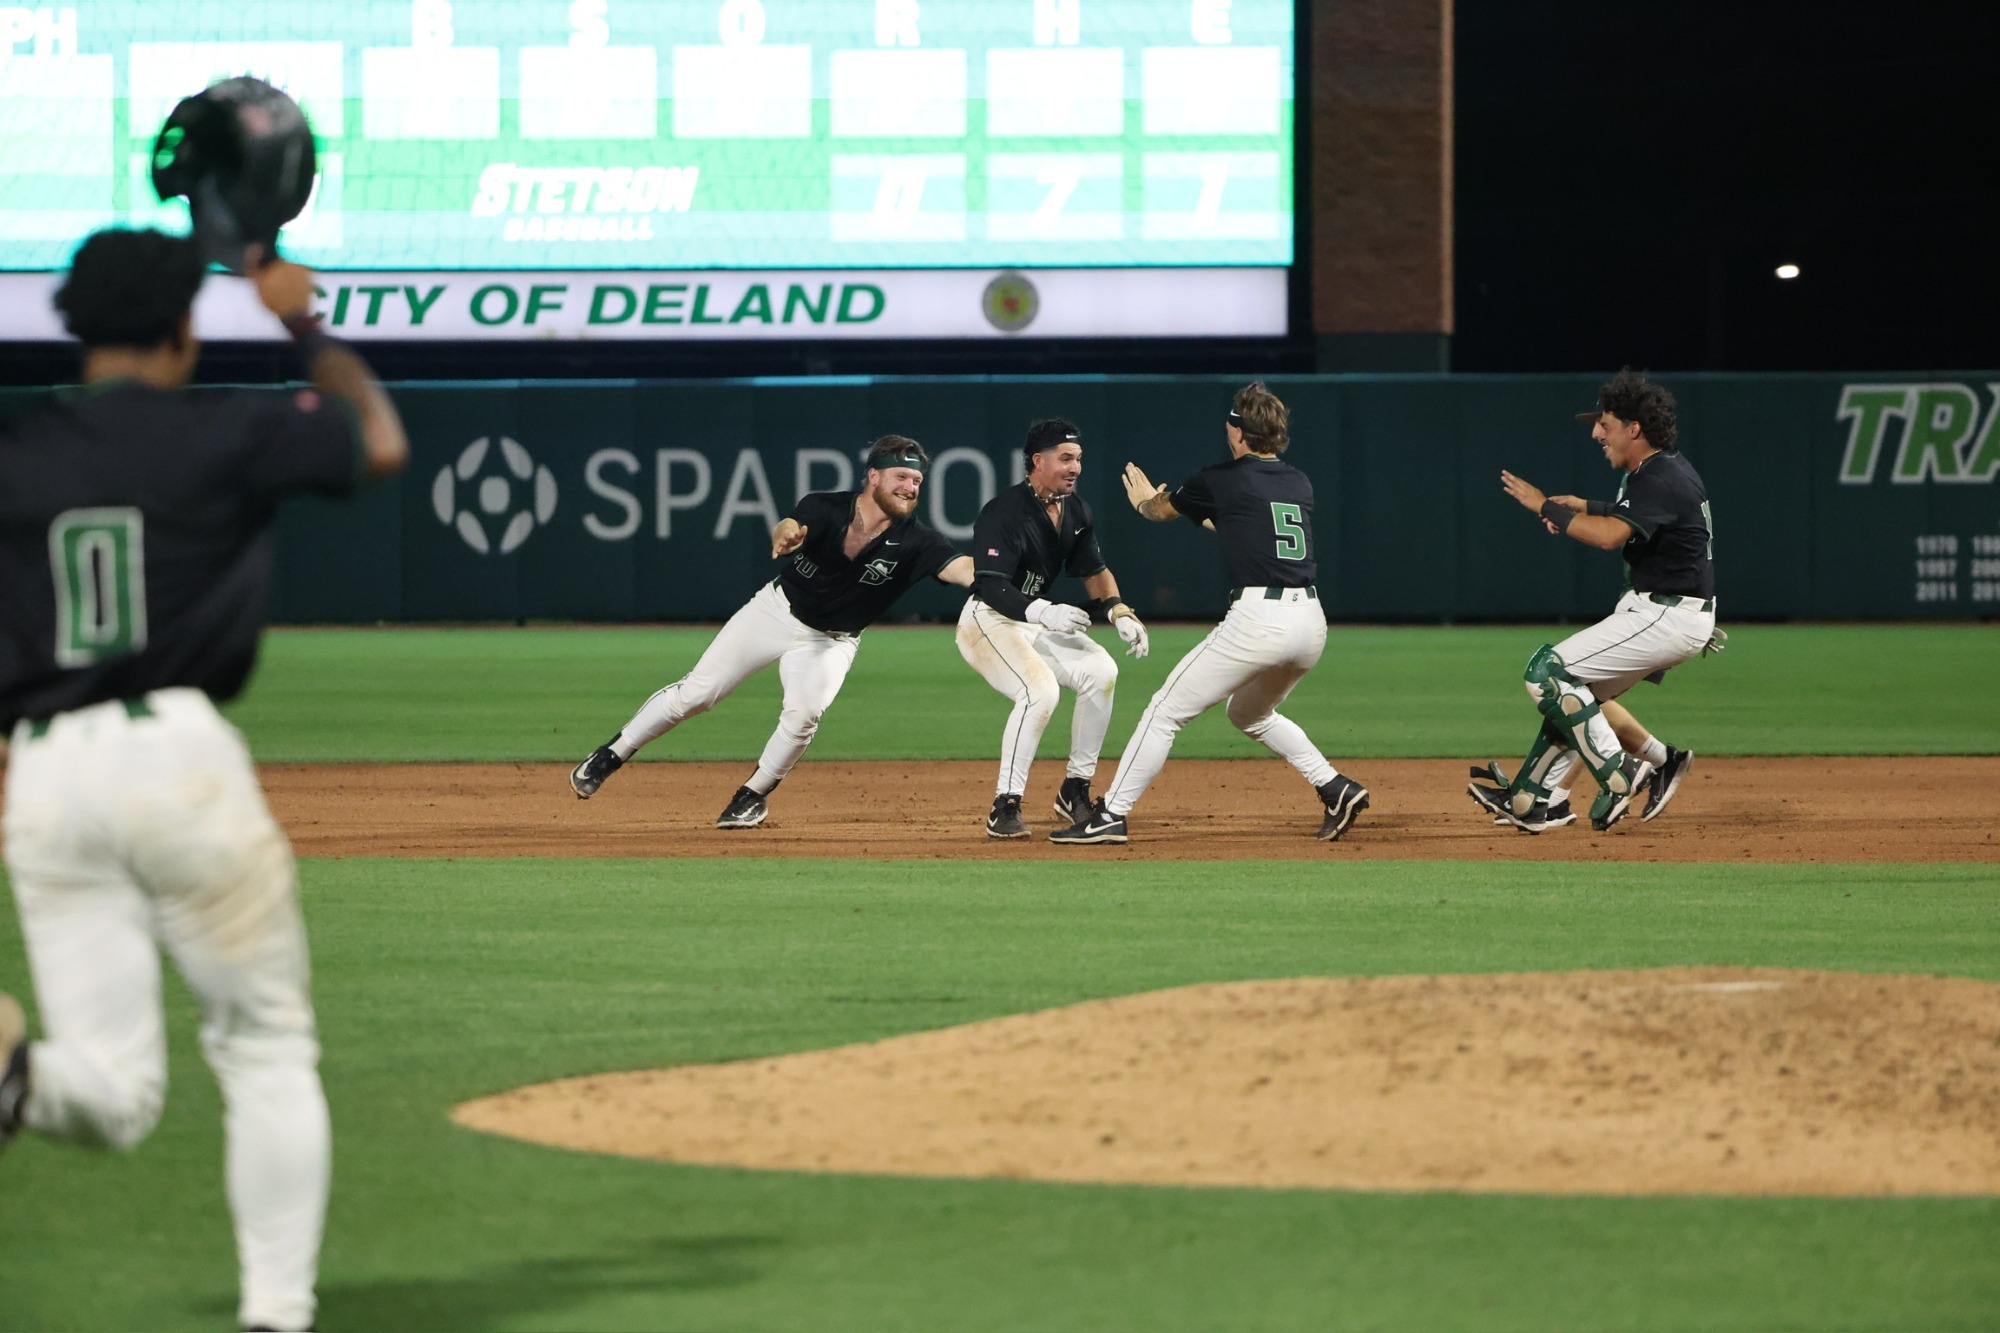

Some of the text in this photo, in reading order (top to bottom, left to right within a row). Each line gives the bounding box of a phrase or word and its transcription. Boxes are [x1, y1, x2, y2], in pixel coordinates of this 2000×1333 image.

[877, 0, 919, 45] R
[1035, 0, 1079, 44] H
[1192, 0, 1232, 43] E
[471, 162, 699, 217] STETSON
[1028, 165, 1082, 229] 7
[469, 284, 568, 326] OF
[587, 284, 886, 324] DELAND
[1270, 502, 1307, 560] 5
[48, 506, 148, 669] 0
